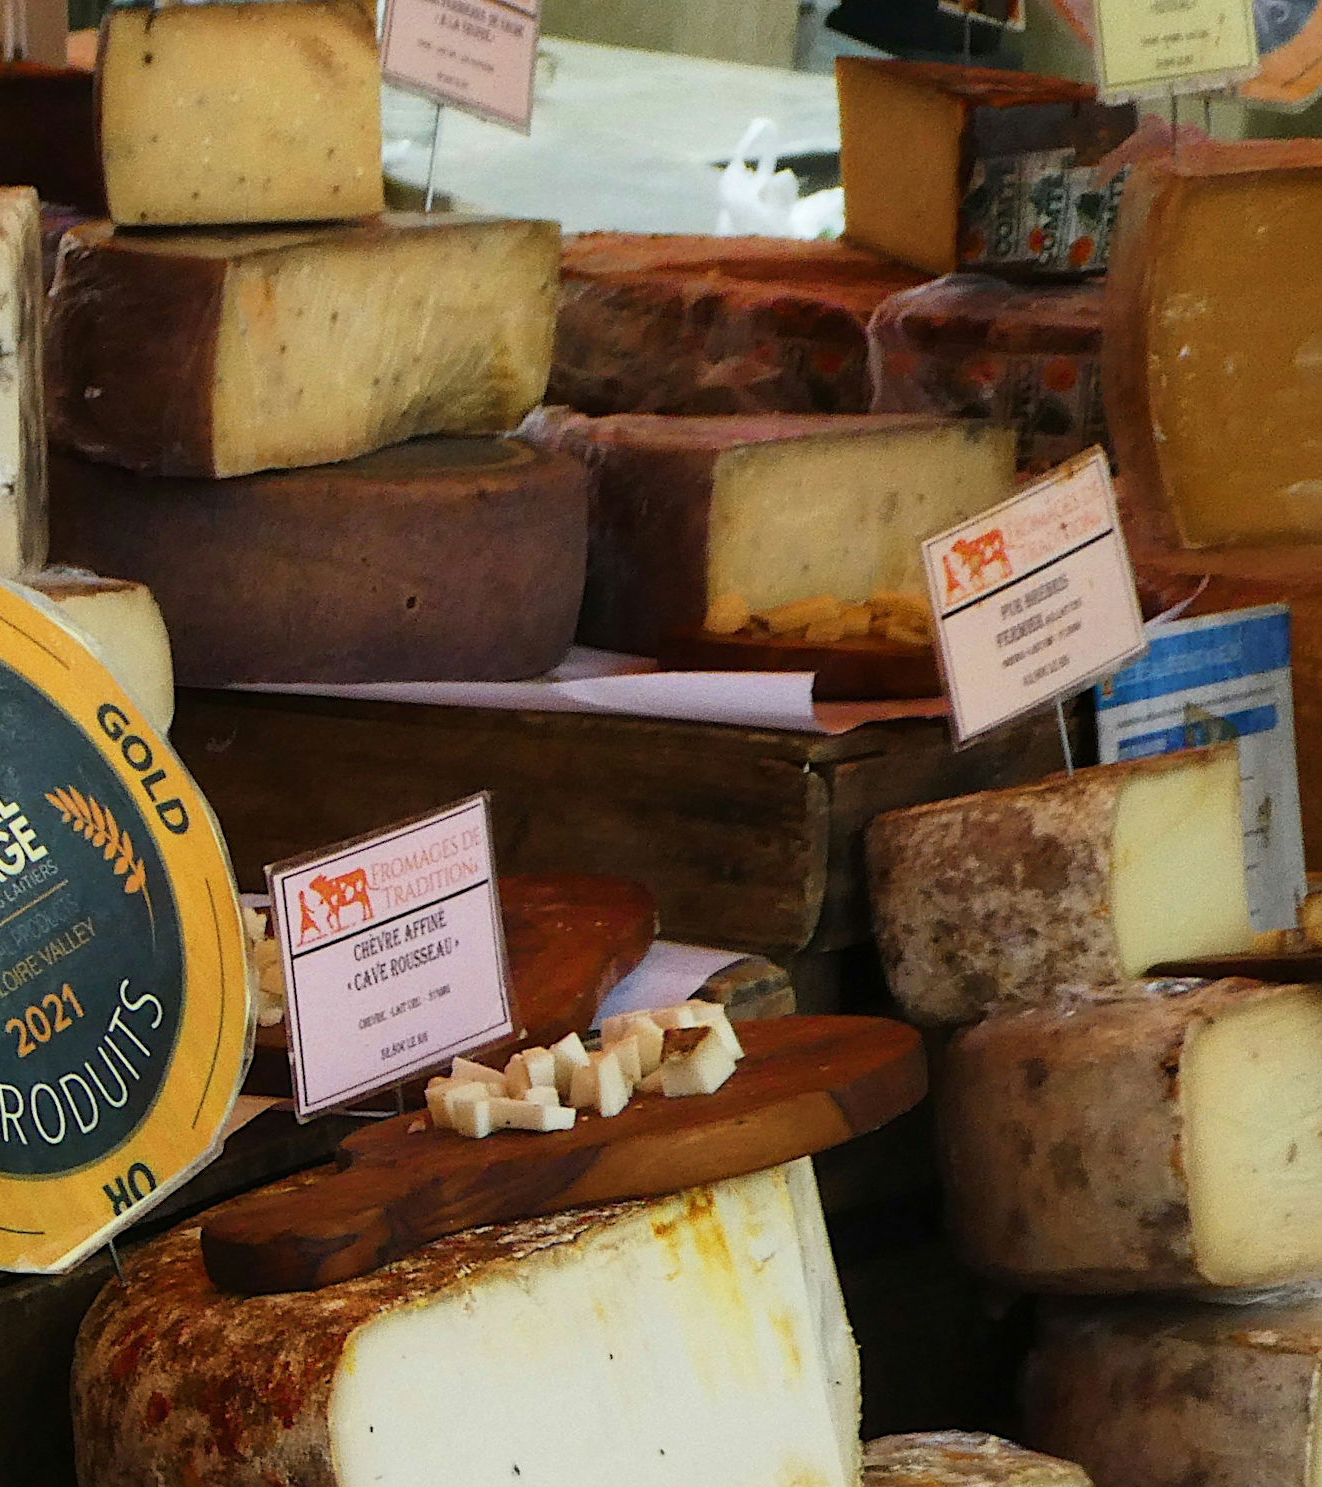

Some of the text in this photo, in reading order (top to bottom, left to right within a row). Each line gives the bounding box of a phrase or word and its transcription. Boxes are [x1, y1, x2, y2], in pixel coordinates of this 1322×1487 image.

[94, 702, 193, 838] GOLD
[370, 835, 459, 887] FROMAGES
[38, 915, 97, 967] VALLEY
[389, 936, 453, 977] ROUSSEAU
[5, 983, 85, 1059] 2021
